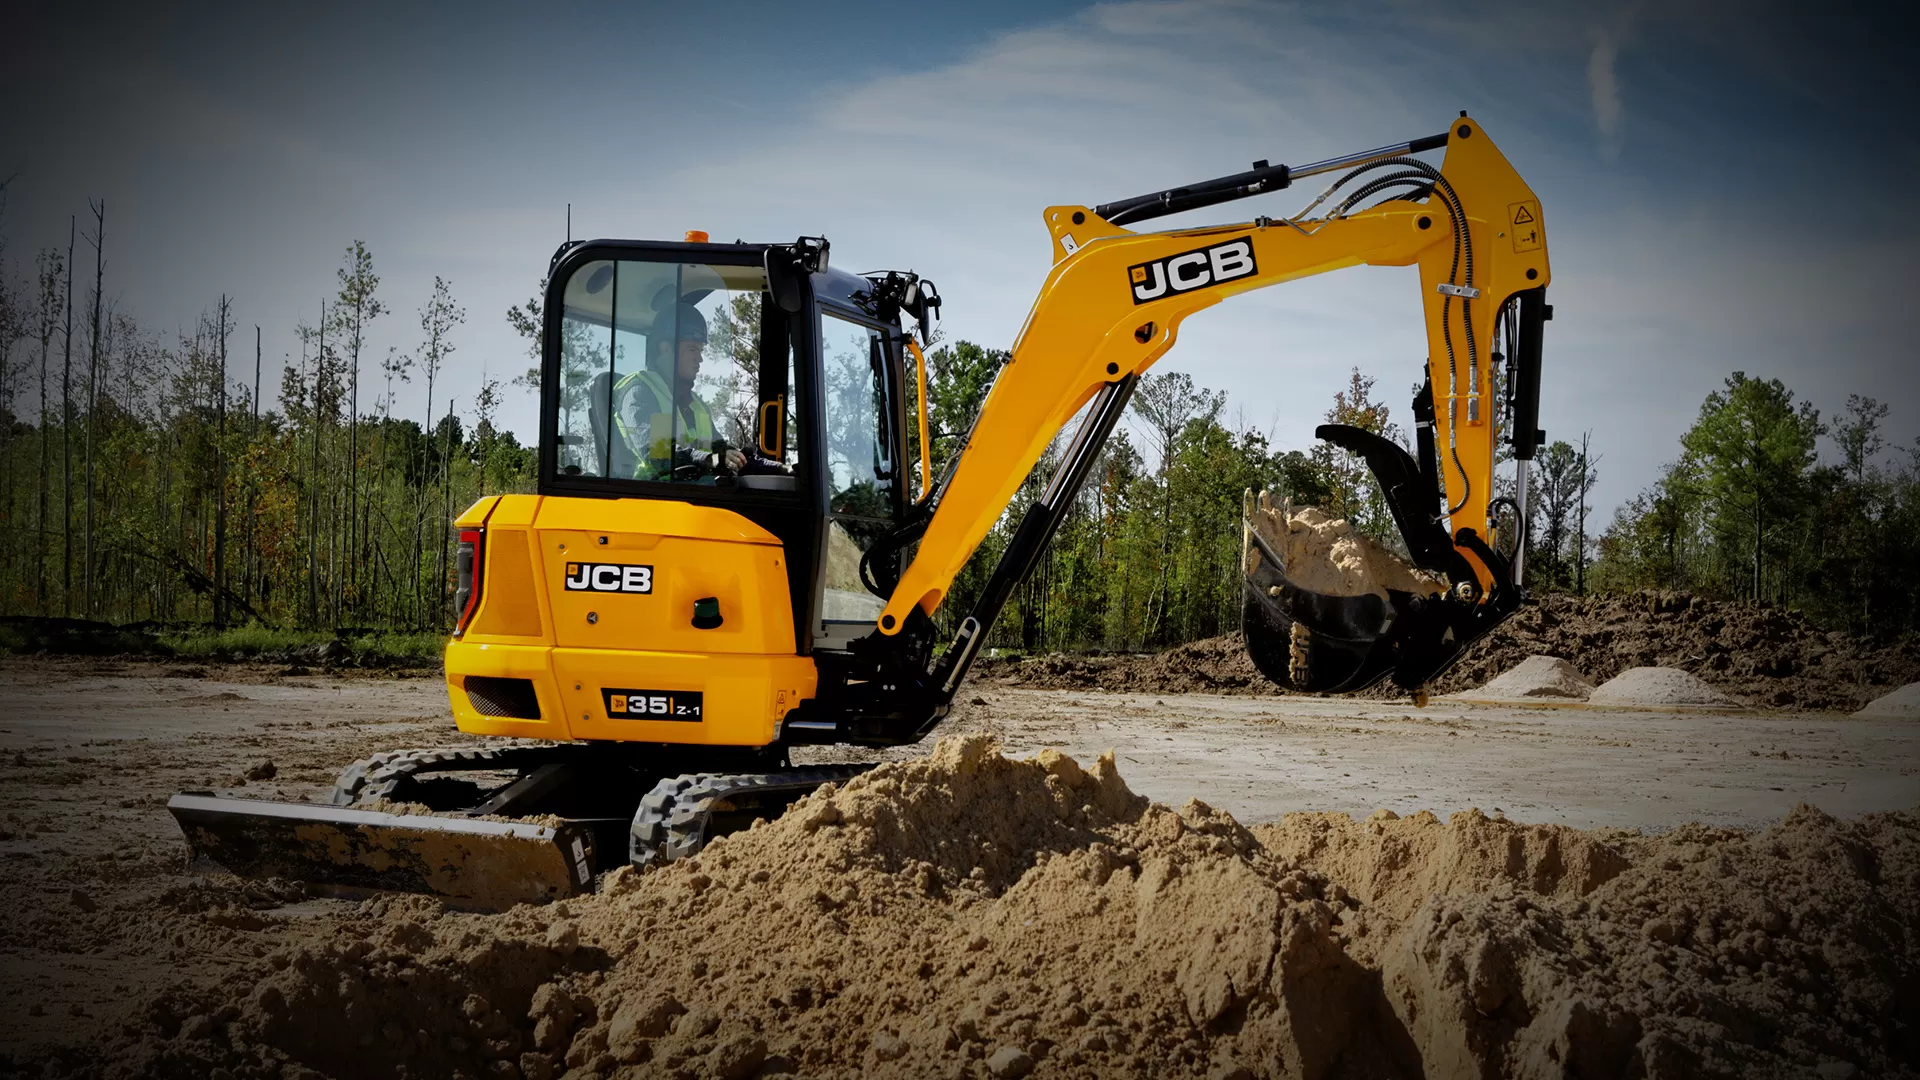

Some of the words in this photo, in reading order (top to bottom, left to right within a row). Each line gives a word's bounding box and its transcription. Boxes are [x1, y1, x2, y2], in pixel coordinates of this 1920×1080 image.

[1133, 241, 1254, 300] JCB
[567, 565, 651, 592] JCB
[628, 695, 668, 714] 35
[676, 705, 700, 716] Z-1
